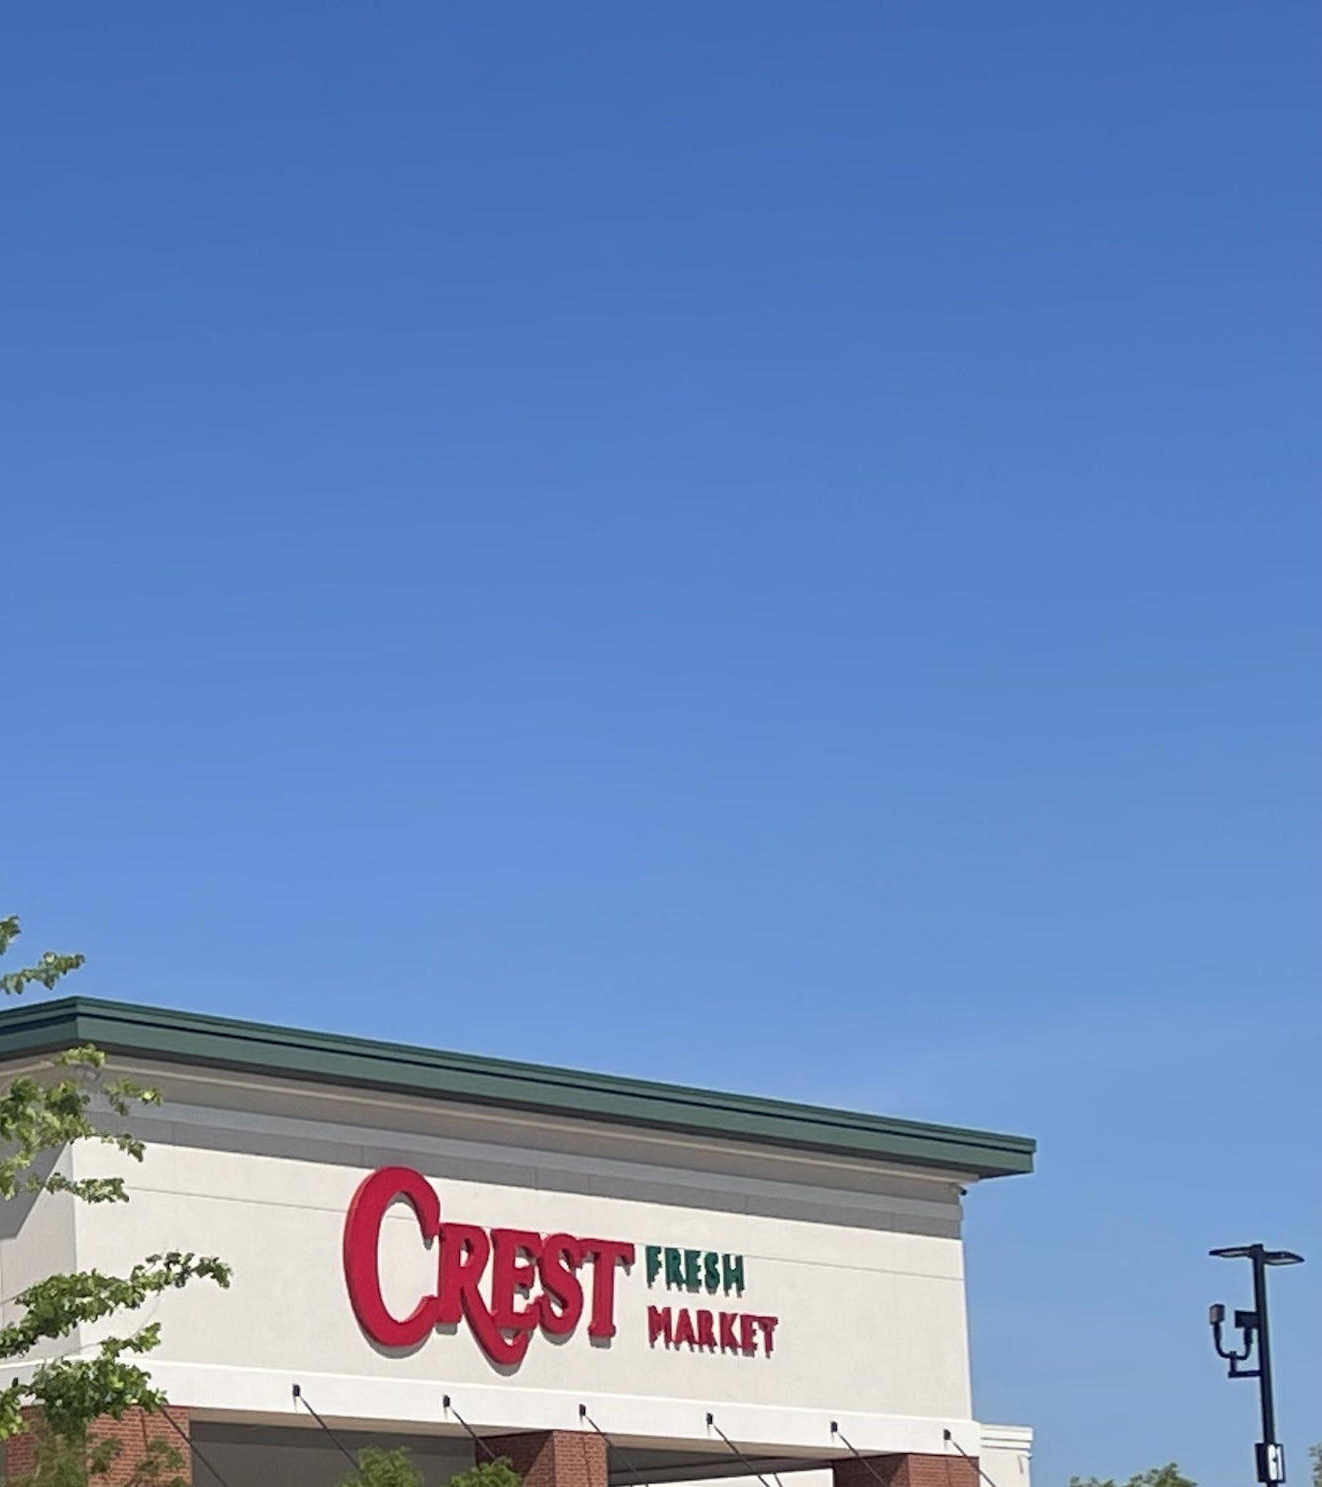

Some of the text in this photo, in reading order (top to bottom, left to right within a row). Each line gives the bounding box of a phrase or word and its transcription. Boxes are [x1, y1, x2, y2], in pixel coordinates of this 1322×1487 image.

[343, 1166, 635, 1366] CREST
[645, 1245, 747, 1293] FRESH
[647, 1305, 780, 1355] MARKET
